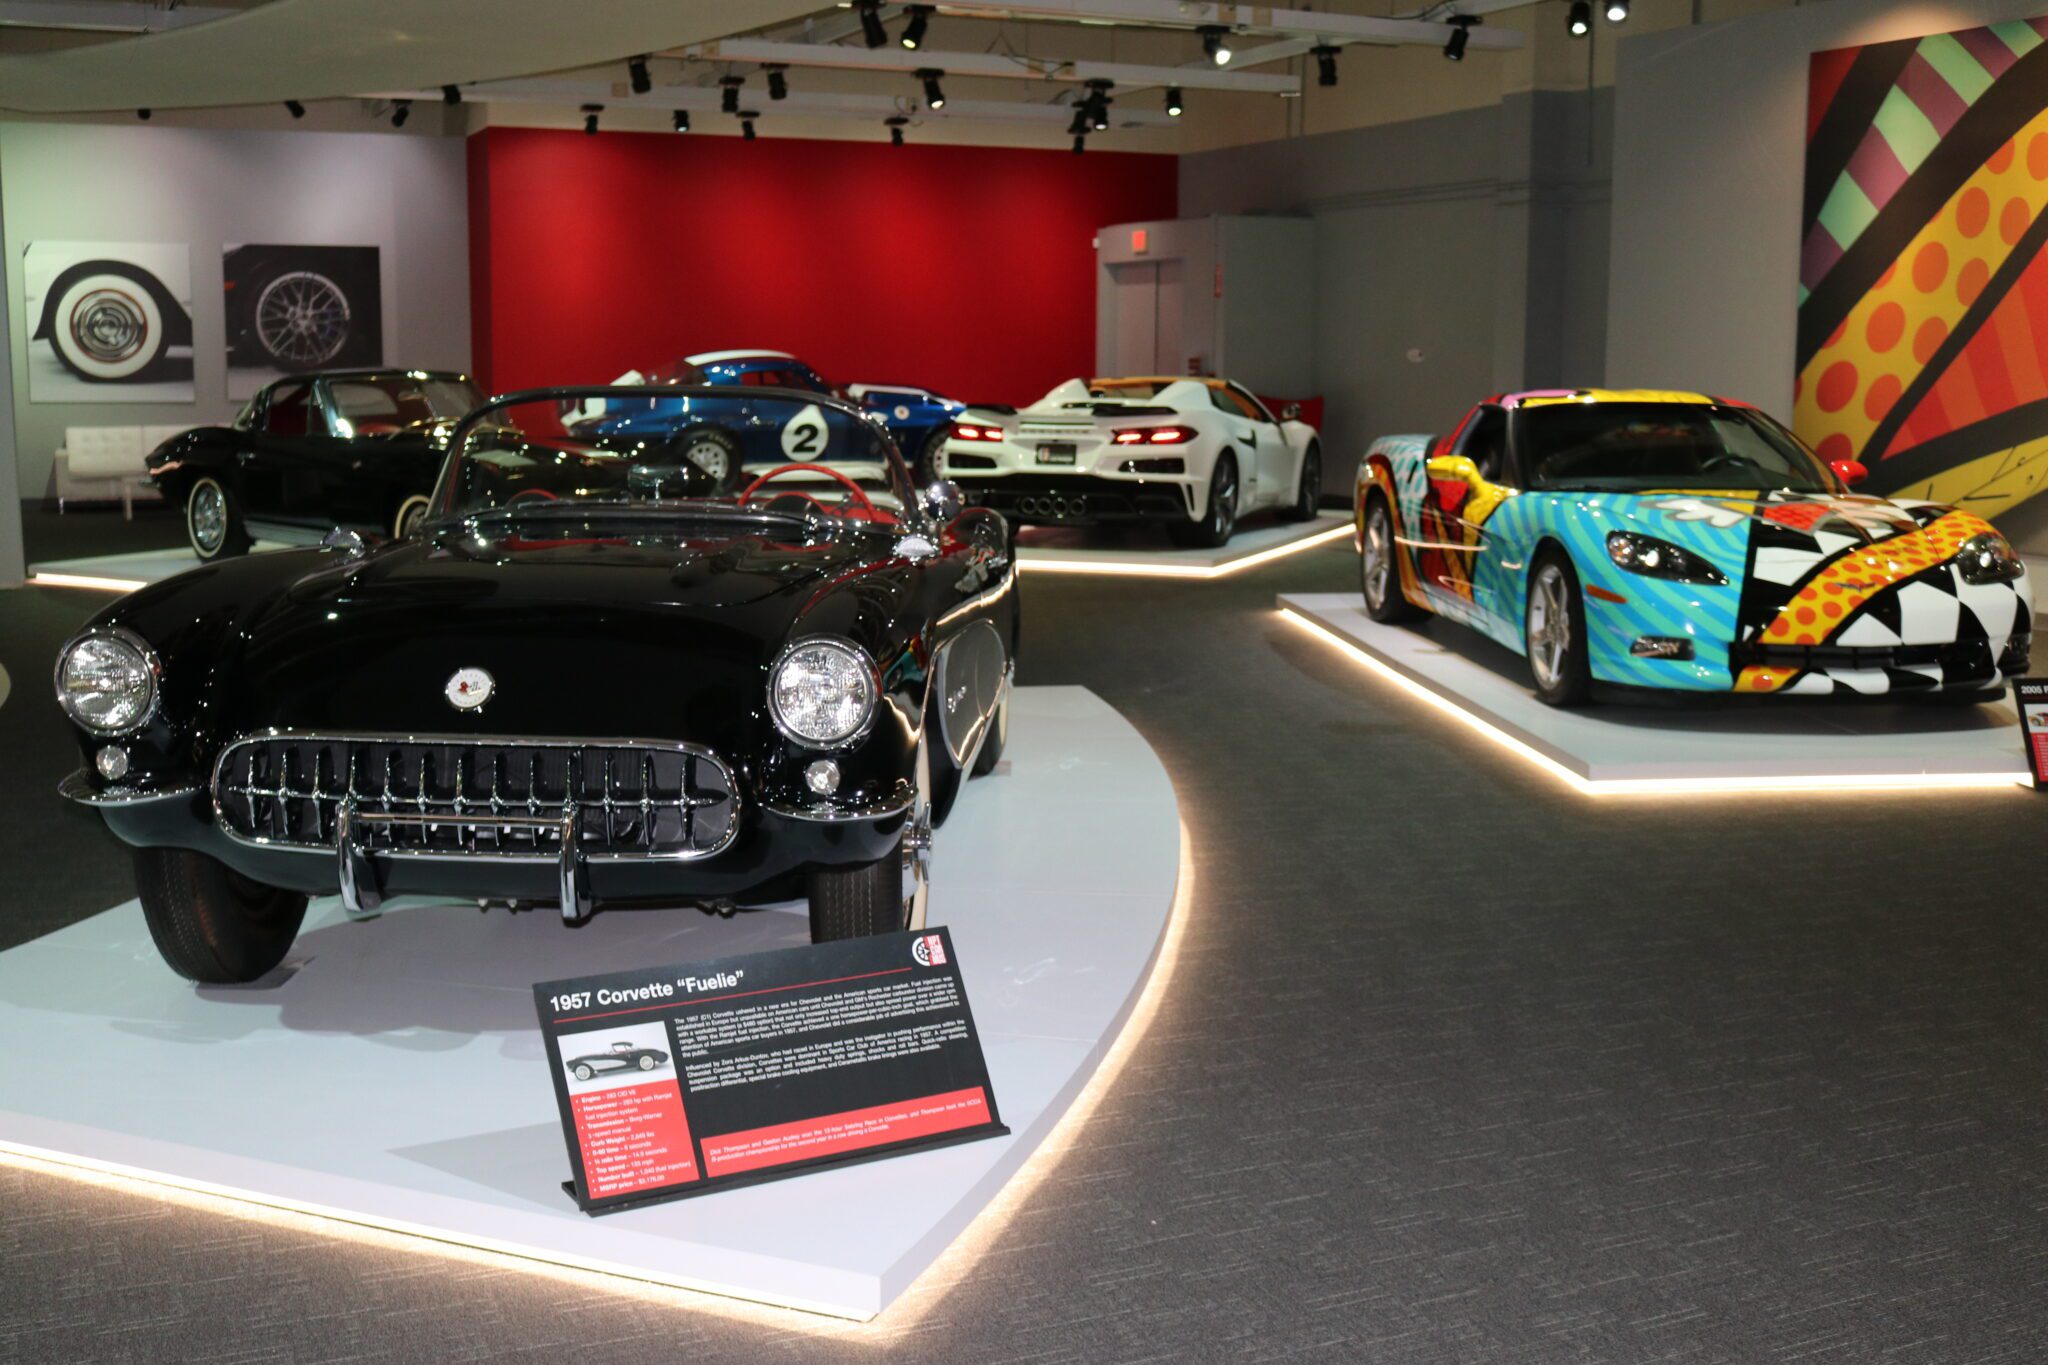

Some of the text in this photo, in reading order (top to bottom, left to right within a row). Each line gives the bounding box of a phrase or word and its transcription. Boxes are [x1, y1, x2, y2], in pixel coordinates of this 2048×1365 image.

[792, 424, 819, 453] 2
[550, 991, 591, 1012] 1957
[597, 982, 674, 1006] Corvette
